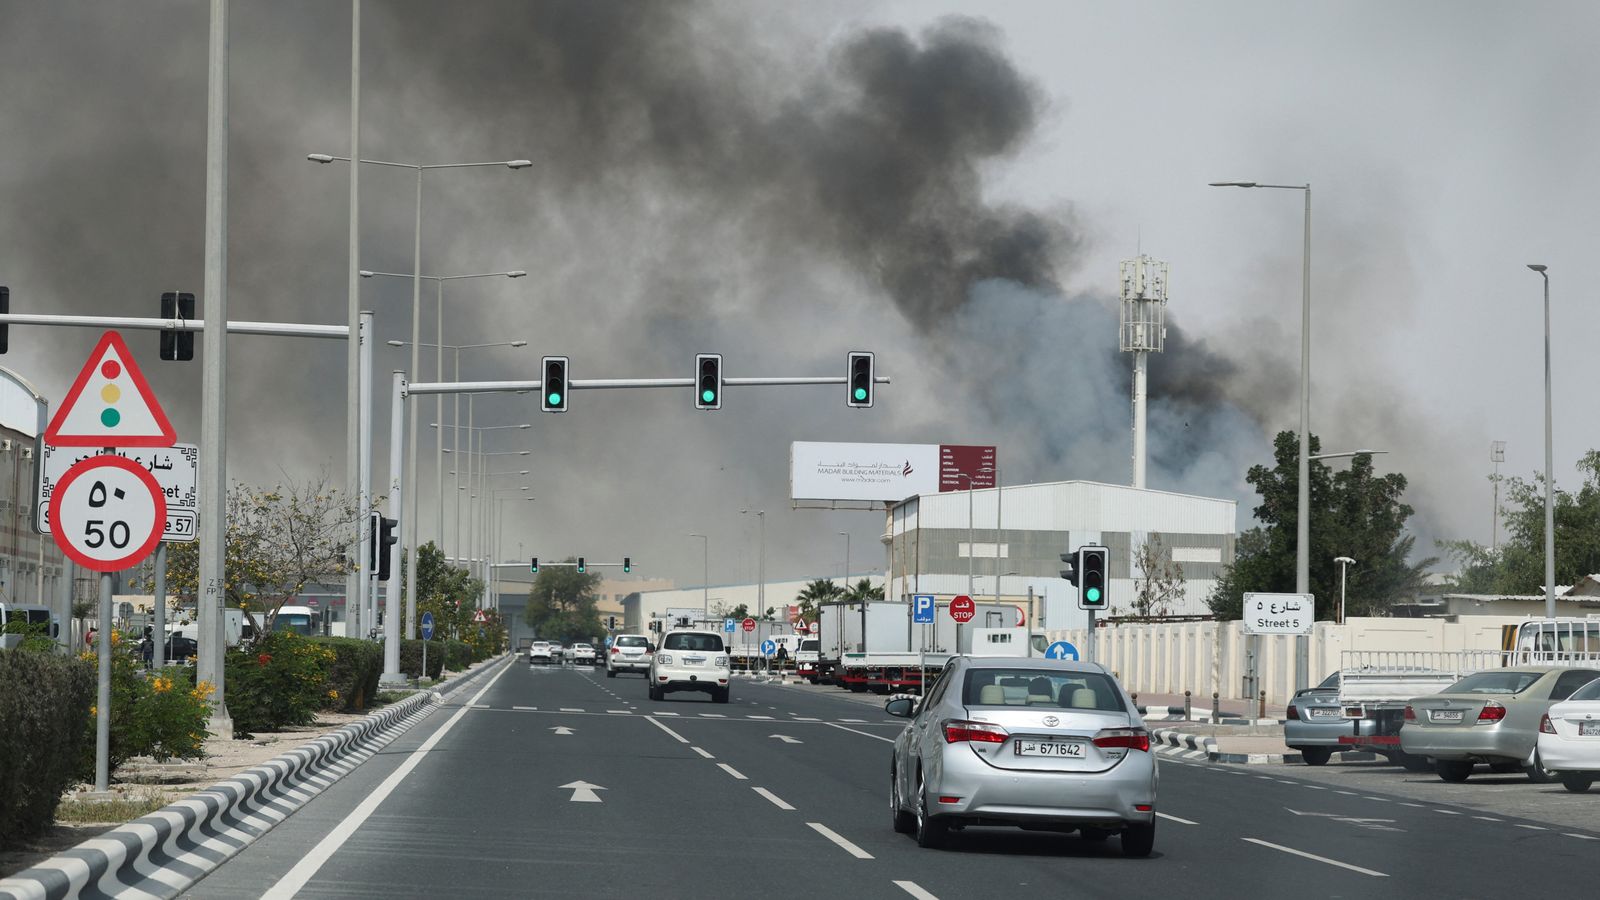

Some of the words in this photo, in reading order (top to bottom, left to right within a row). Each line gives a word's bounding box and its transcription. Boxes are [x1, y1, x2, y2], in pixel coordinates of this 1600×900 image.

[88, 480, 126, 508] ٥٠
[175, 518, 192, 533] 57
[84, 519, 131, 549] 50
[917, 597, 931, 615] P
[955, 600, 970, 609] قف
[1257, 601, 1263, 610] ٥
[1270, 601, 1301, 615] شارع
[726, 619, 734, 629] P
[1257, 618, 1290, 628] Street
[1293, 618, 1300, 628] 5
[1023, 744, 1036, 753] قطر
[1040, 743, 1080, 756] 671642
